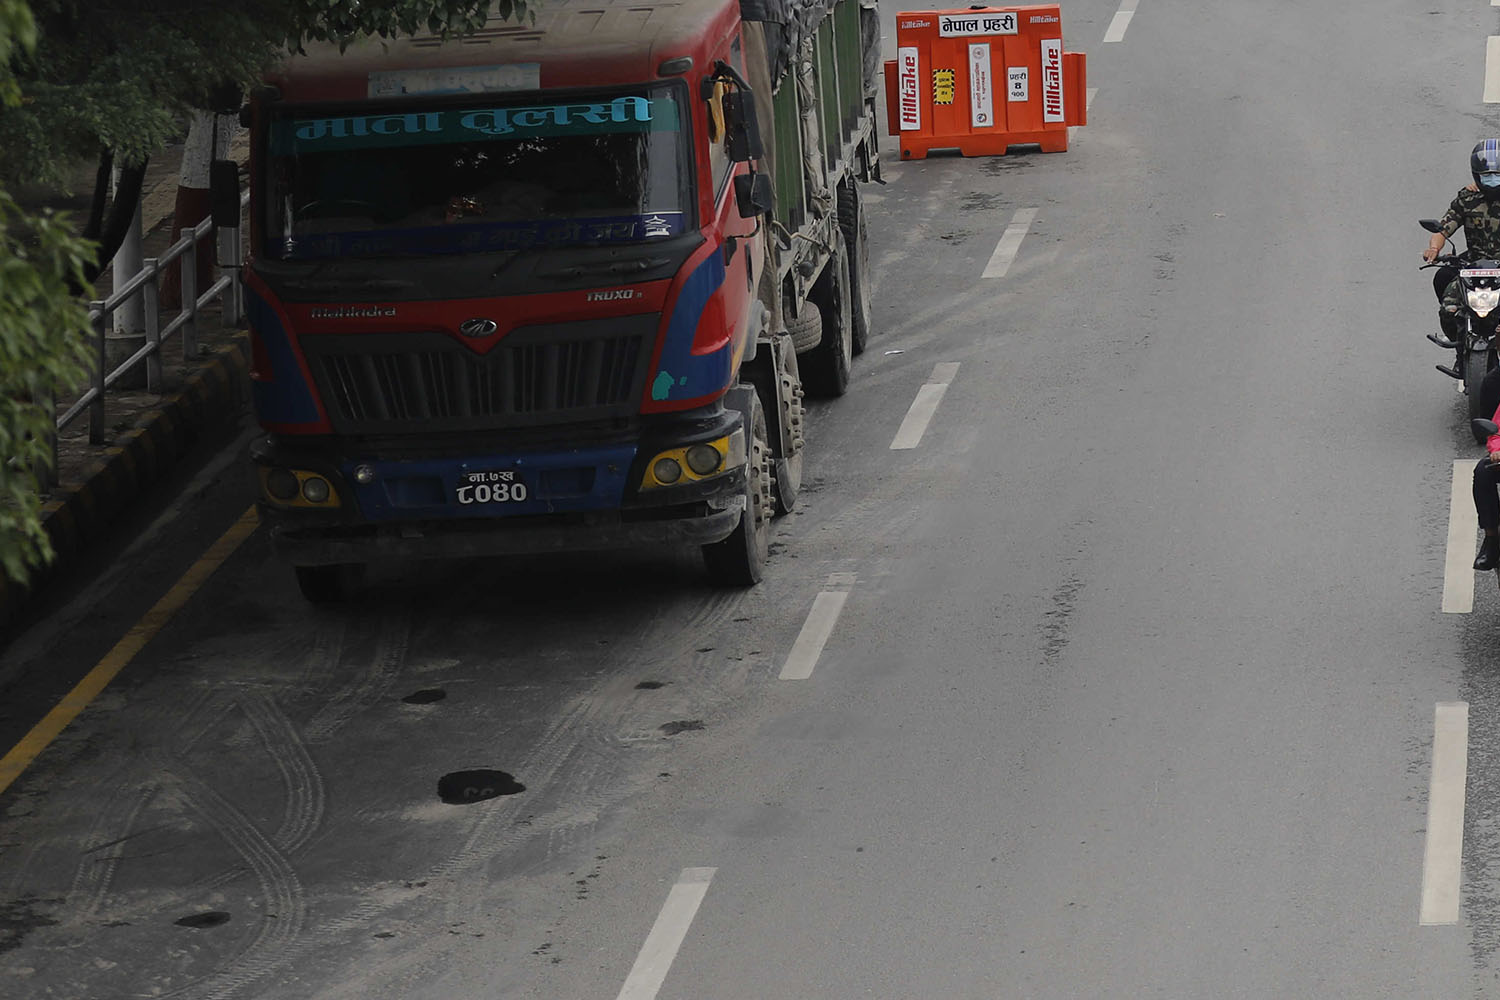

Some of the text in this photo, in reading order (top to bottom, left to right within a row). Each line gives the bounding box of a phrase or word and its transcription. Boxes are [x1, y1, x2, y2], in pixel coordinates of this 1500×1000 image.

[942, 15, 1014, 33] नेपाल प्रहरी
[902, 55, 917, 124] Hilltake
[1044, 48, 1061, 116] Hilltake
[296, 96, 654, 140] माता तुलसी
[586, 288, 635, 302] TRUXO
[456, 483, 528, 504] ८०४०
